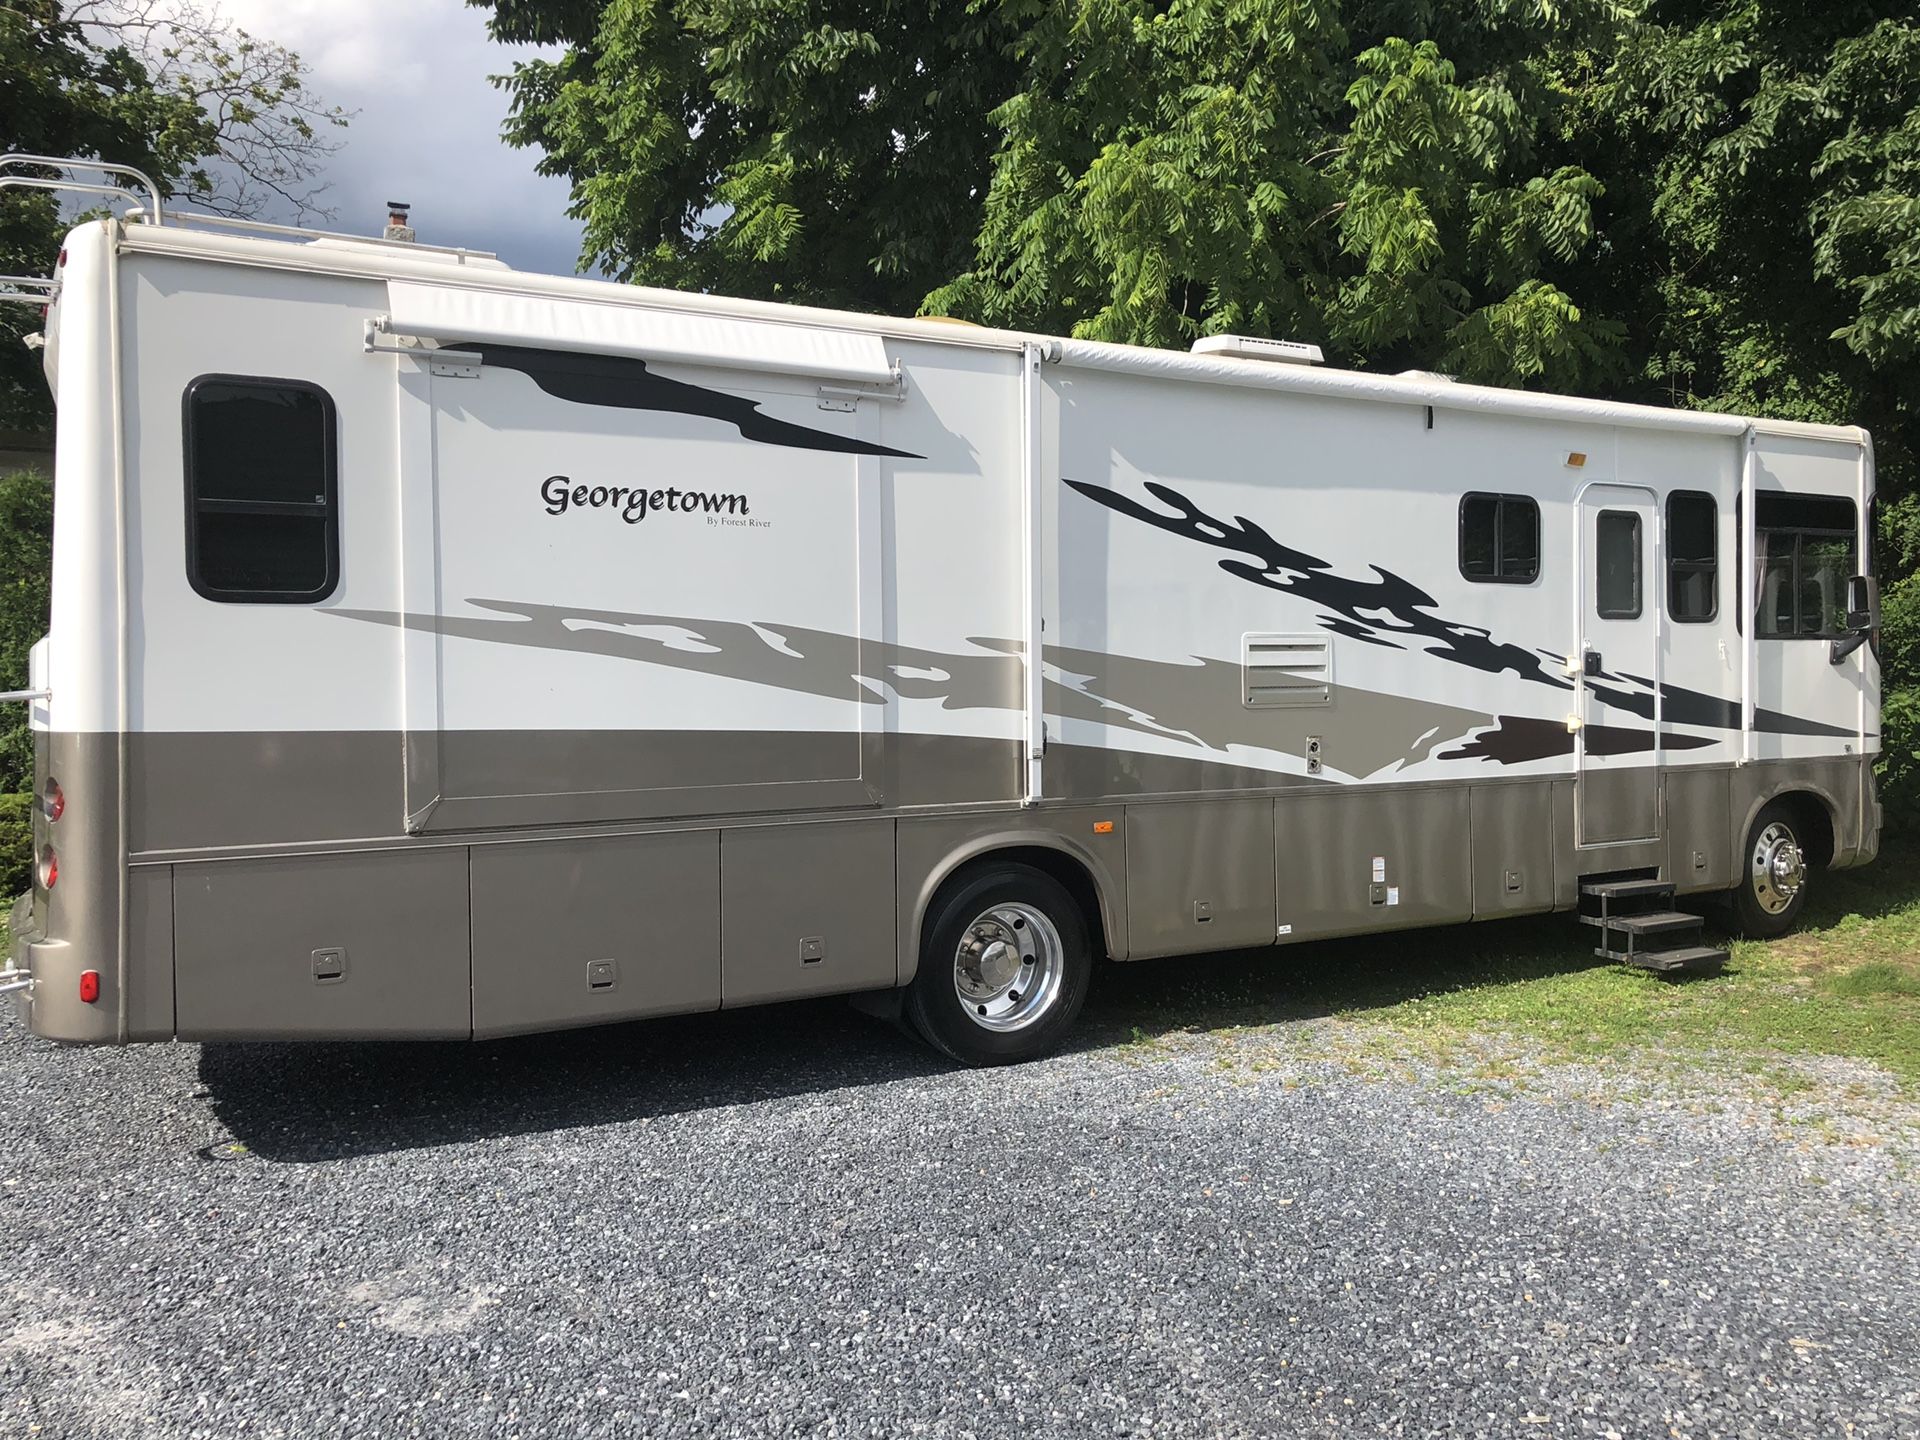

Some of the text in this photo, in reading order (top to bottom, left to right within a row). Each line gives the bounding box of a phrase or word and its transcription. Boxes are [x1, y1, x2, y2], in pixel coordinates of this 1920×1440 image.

[540, 475, 750, 524] Georgetown
[706, 516, 771, 528] By Forest River
